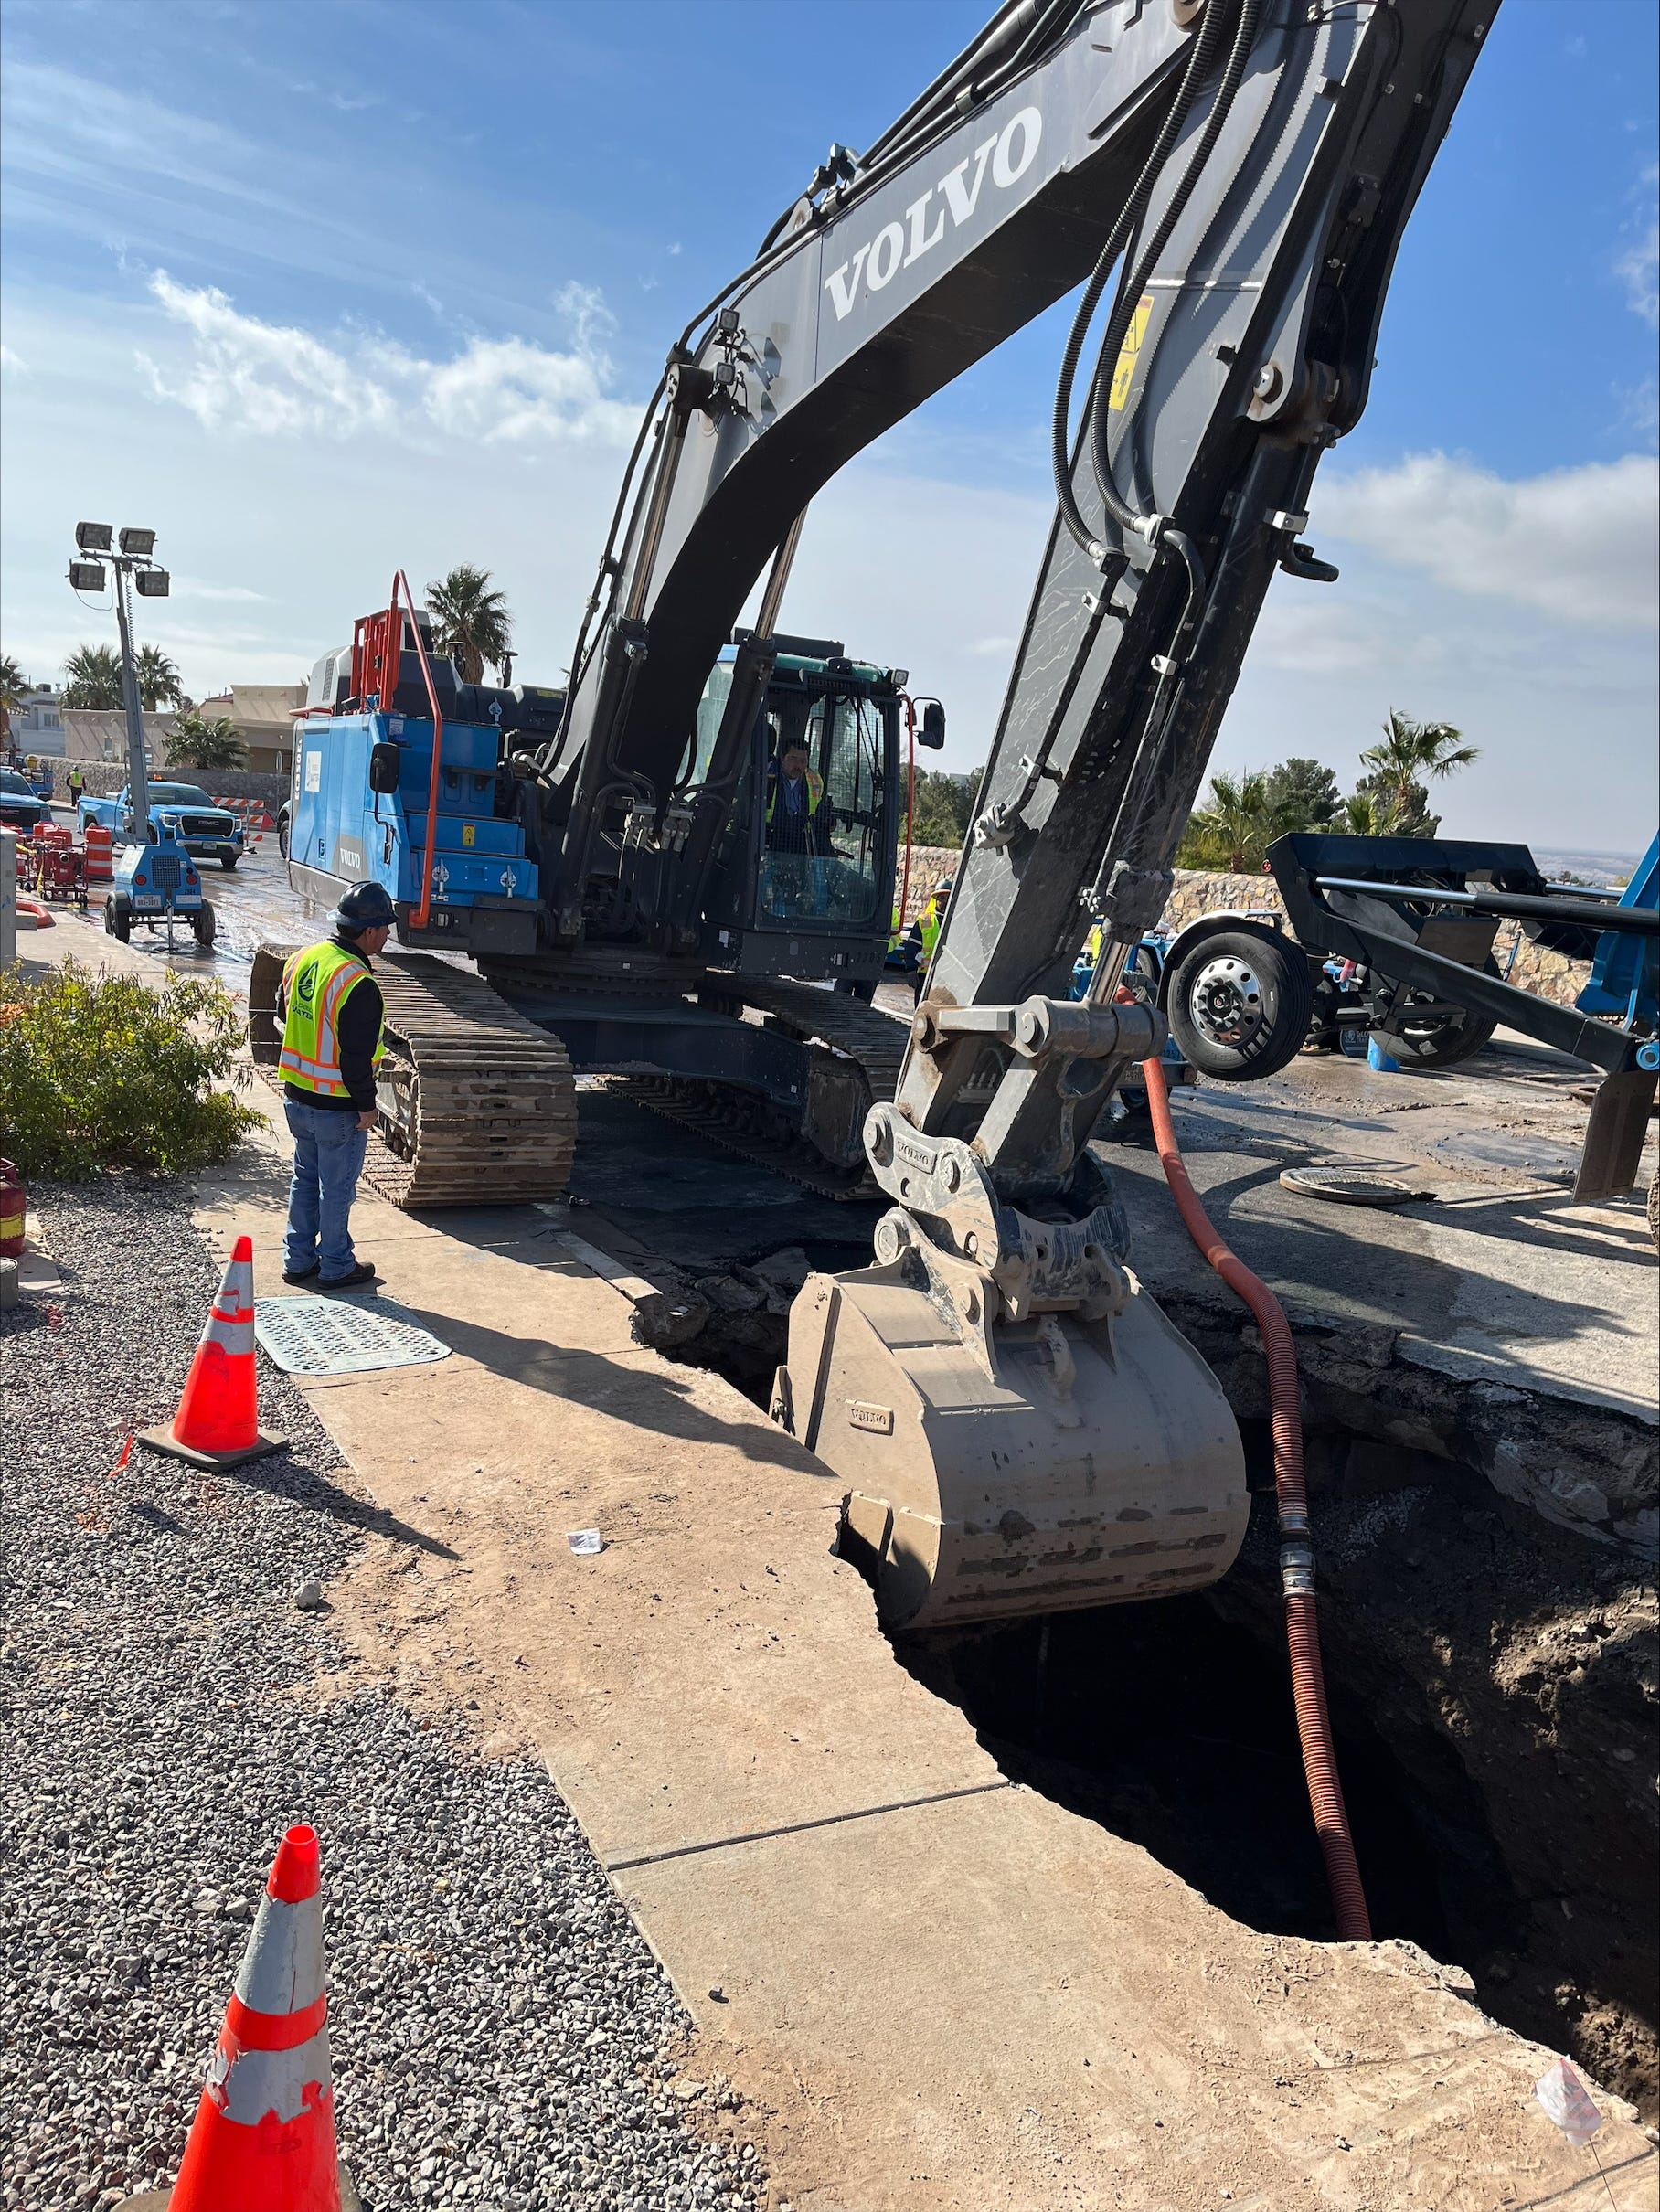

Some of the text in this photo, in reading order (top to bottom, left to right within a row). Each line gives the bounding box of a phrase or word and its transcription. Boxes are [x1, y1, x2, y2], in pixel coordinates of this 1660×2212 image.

[825, 106, 1043, 321] VOLVO
[340, 847, 361, 869] VOLVO
[897, 1141, 929, 1165] VOLVO
[850, 1408, 887, 1425] VOLVO
